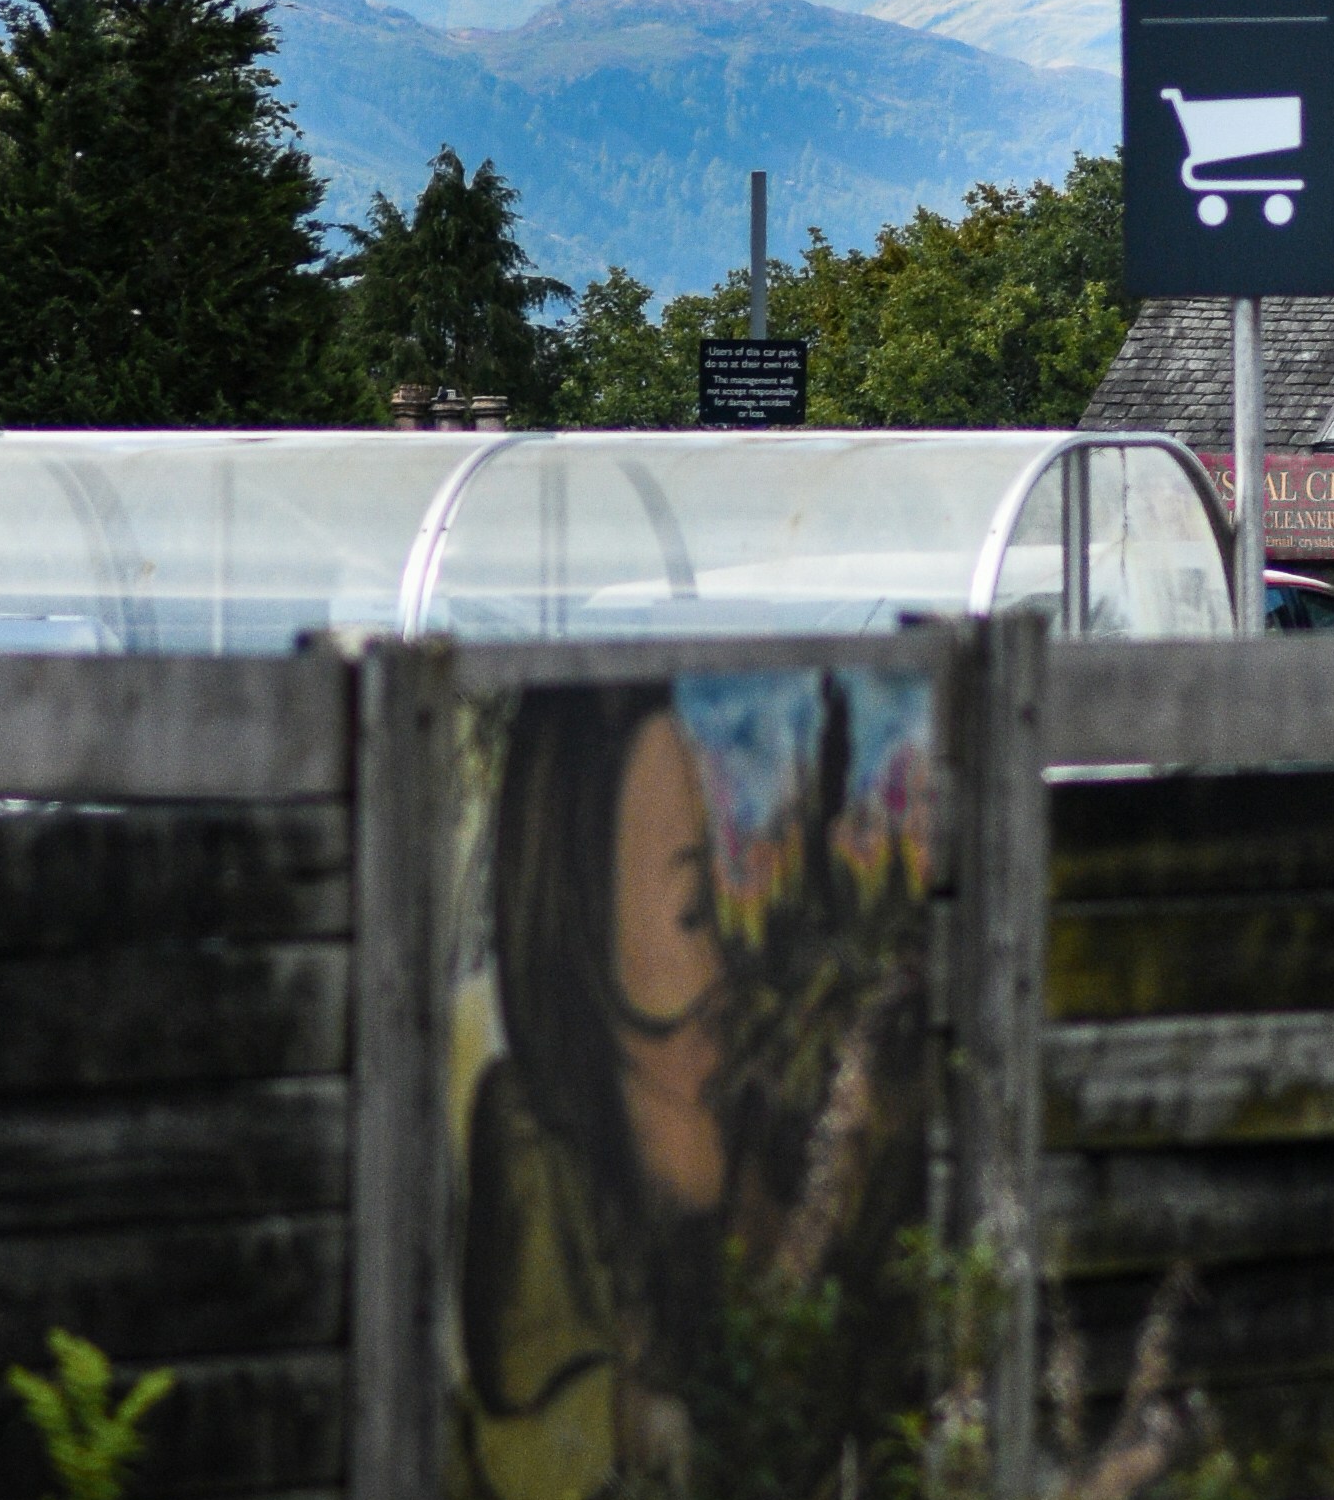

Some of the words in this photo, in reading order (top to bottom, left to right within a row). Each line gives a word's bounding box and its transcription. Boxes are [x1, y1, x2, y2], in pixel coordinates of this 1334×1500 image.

[709, 346, 733, 356] Users
[734, 346, 744, 356] of
[778, 347, 798, 358] park
[704, 360, 717, 368] do
[713, 375, 729, 384] The
